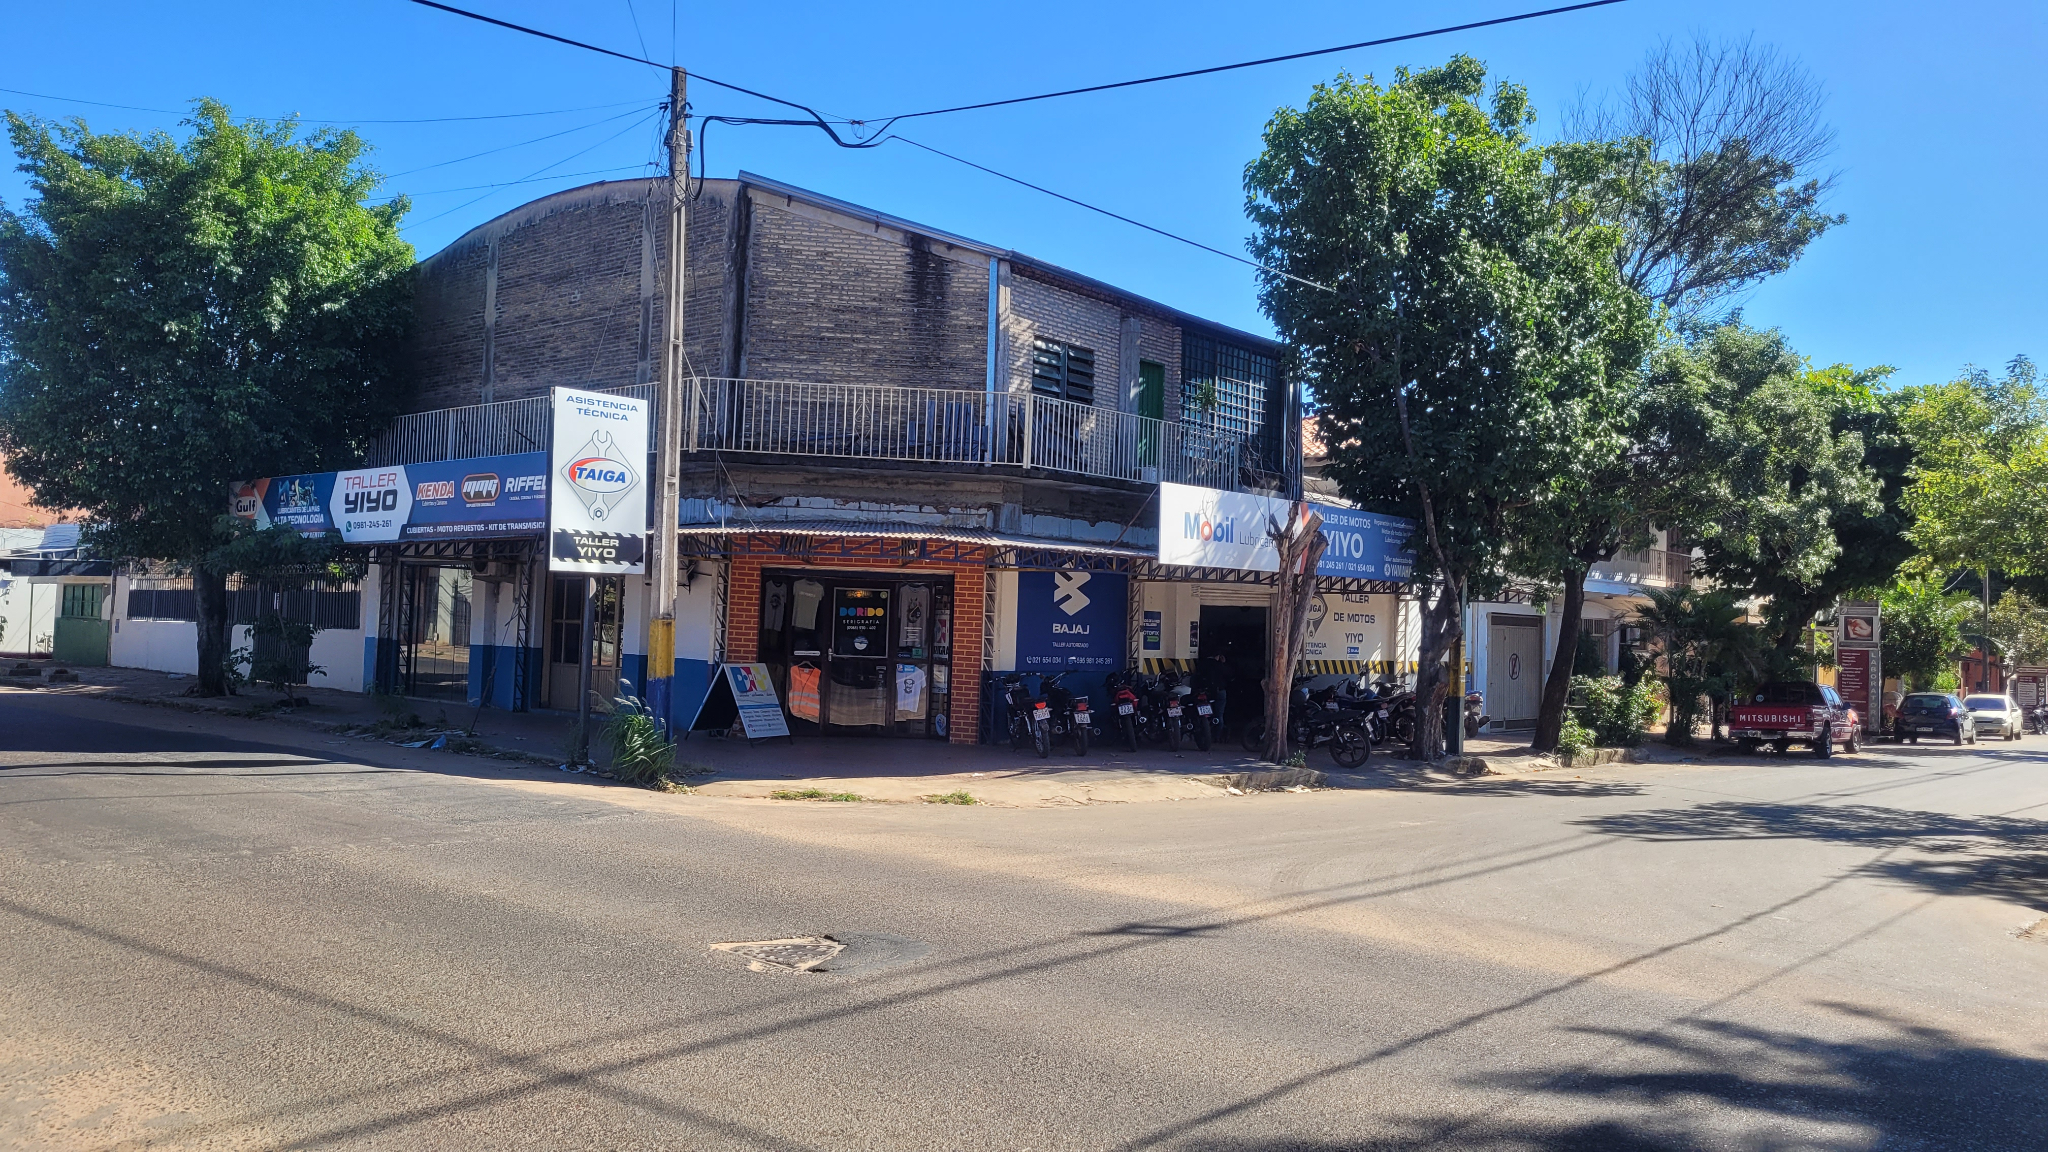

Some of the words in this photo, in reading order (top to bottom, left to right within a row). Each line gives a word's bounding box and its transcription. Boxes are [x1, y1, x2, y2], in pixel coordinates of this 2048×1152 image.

[566, 395, 639, 412] ASISTENCIA
[576, 407, 629, 422] TÉCNICA
[575, 466, 626, 484] TAIGA
[344, 473, 397, 490] TALLER
[416, 481, 455, 500] KENDA
[236, 499, 257, 512] Gulf
[344, 489, 398, 514] YIYO
[352, 519, 392, 530] 0981-245-261
[1322, 512, 1339, 525] LLER
[1339, 515, 1348, 526] DE
[1349, 516, 1371, 529] MOTOS
[407, 526, 433, 534] CUBIERTAS
[437, 525, 453, 533] MOTO
[454, 523, 484, 532] REPUESTOS
[489, 523, 498, 531] KIT
[499, 522, 506, 531] DE
[1184, 511, 1234, 544] Mobil
[573, 536, 619, 547] TALLER
[1323, 529, 1364, 559] YIYO
[577, 546, 616, 558] YIYO
[1326, 561, 1335, 570] 245
[1335, 561, 1345, 570] 261
[1348, 563, 1357, 571] 021
[1357, 563, 1366, 572] 654
[1366, 564, 1375, 573] 034
[1341, 594, 1369, 604] TALLER
[1333, 612, 1345, 622] DE
[1347, 613, 1376, 624] MOTOS
[1052, 623, 1090, 635] BAJAJ
[1345, 632, 1364, 643] YIYO
[1032, 656, 1041, 664] 021
[1739, 714, 1801, 723] MITSUBISHI
